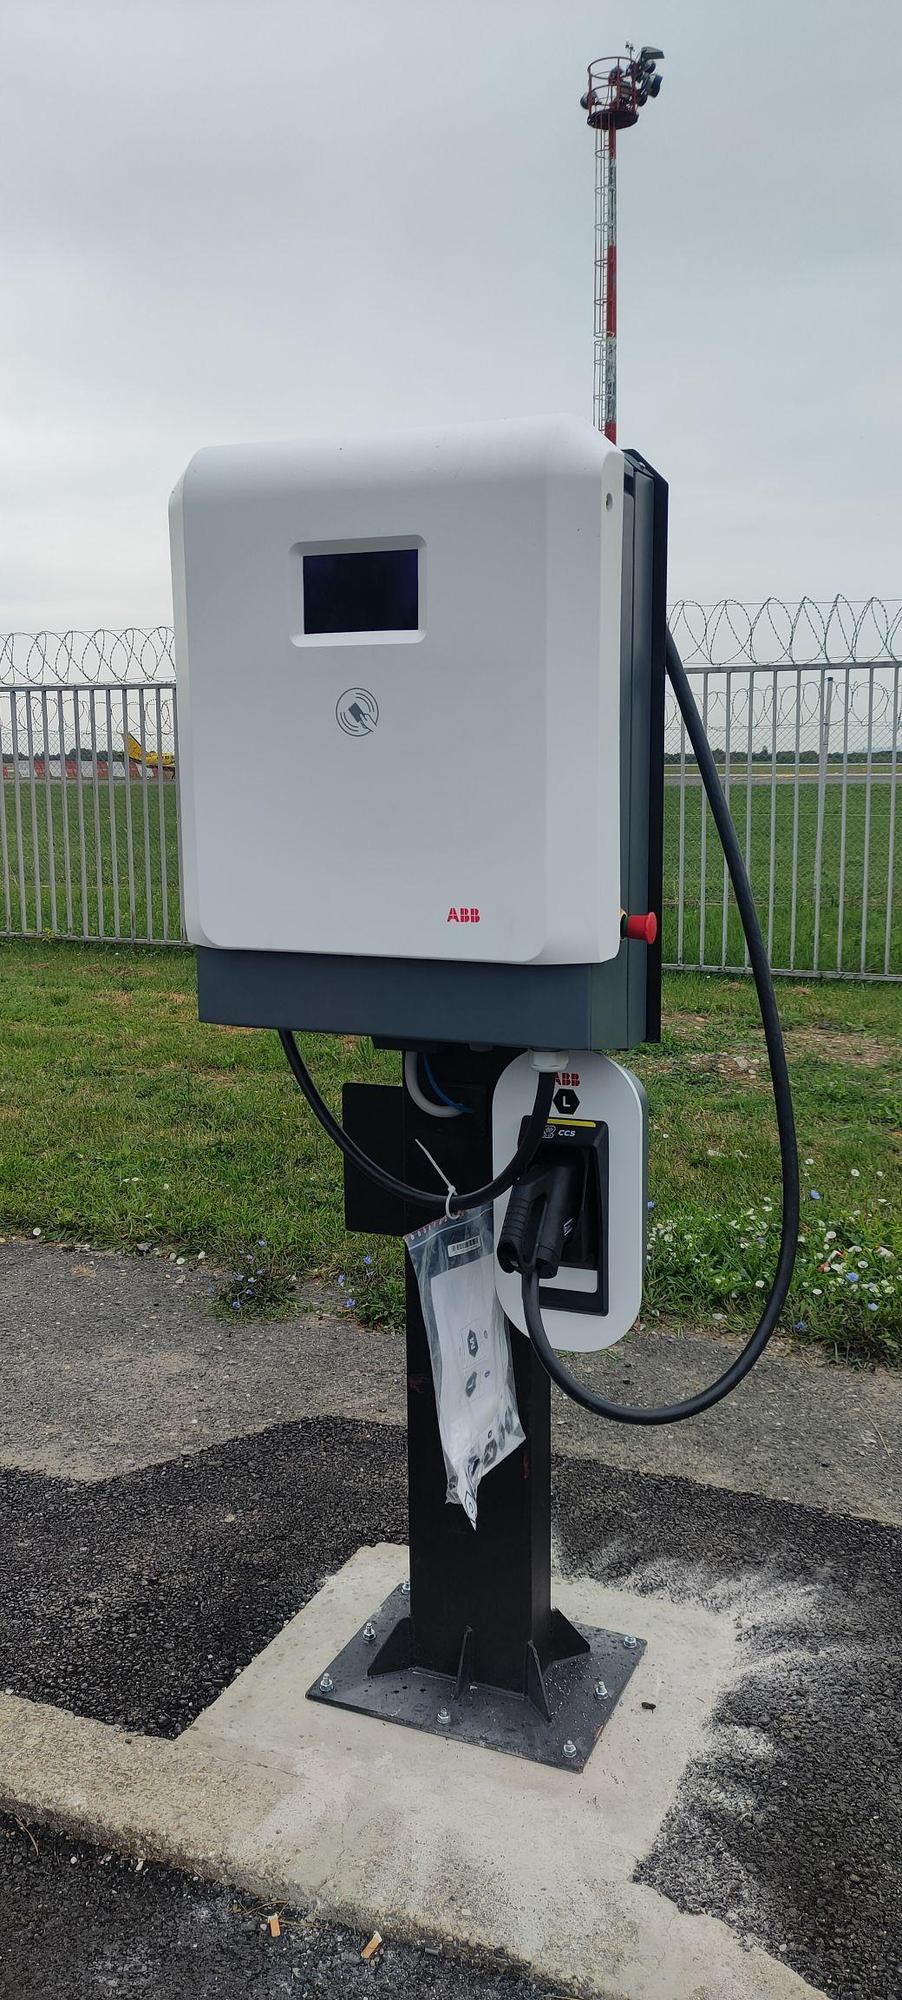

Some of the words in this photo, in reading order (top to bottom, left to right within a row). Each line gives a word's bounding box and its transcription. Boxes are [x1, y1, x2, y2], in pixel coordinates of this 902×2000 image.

[447, 908, 480, 922] ABB
[563, 1096, 570, 1107] L
[558, 1129, 576, 1137] CCS
